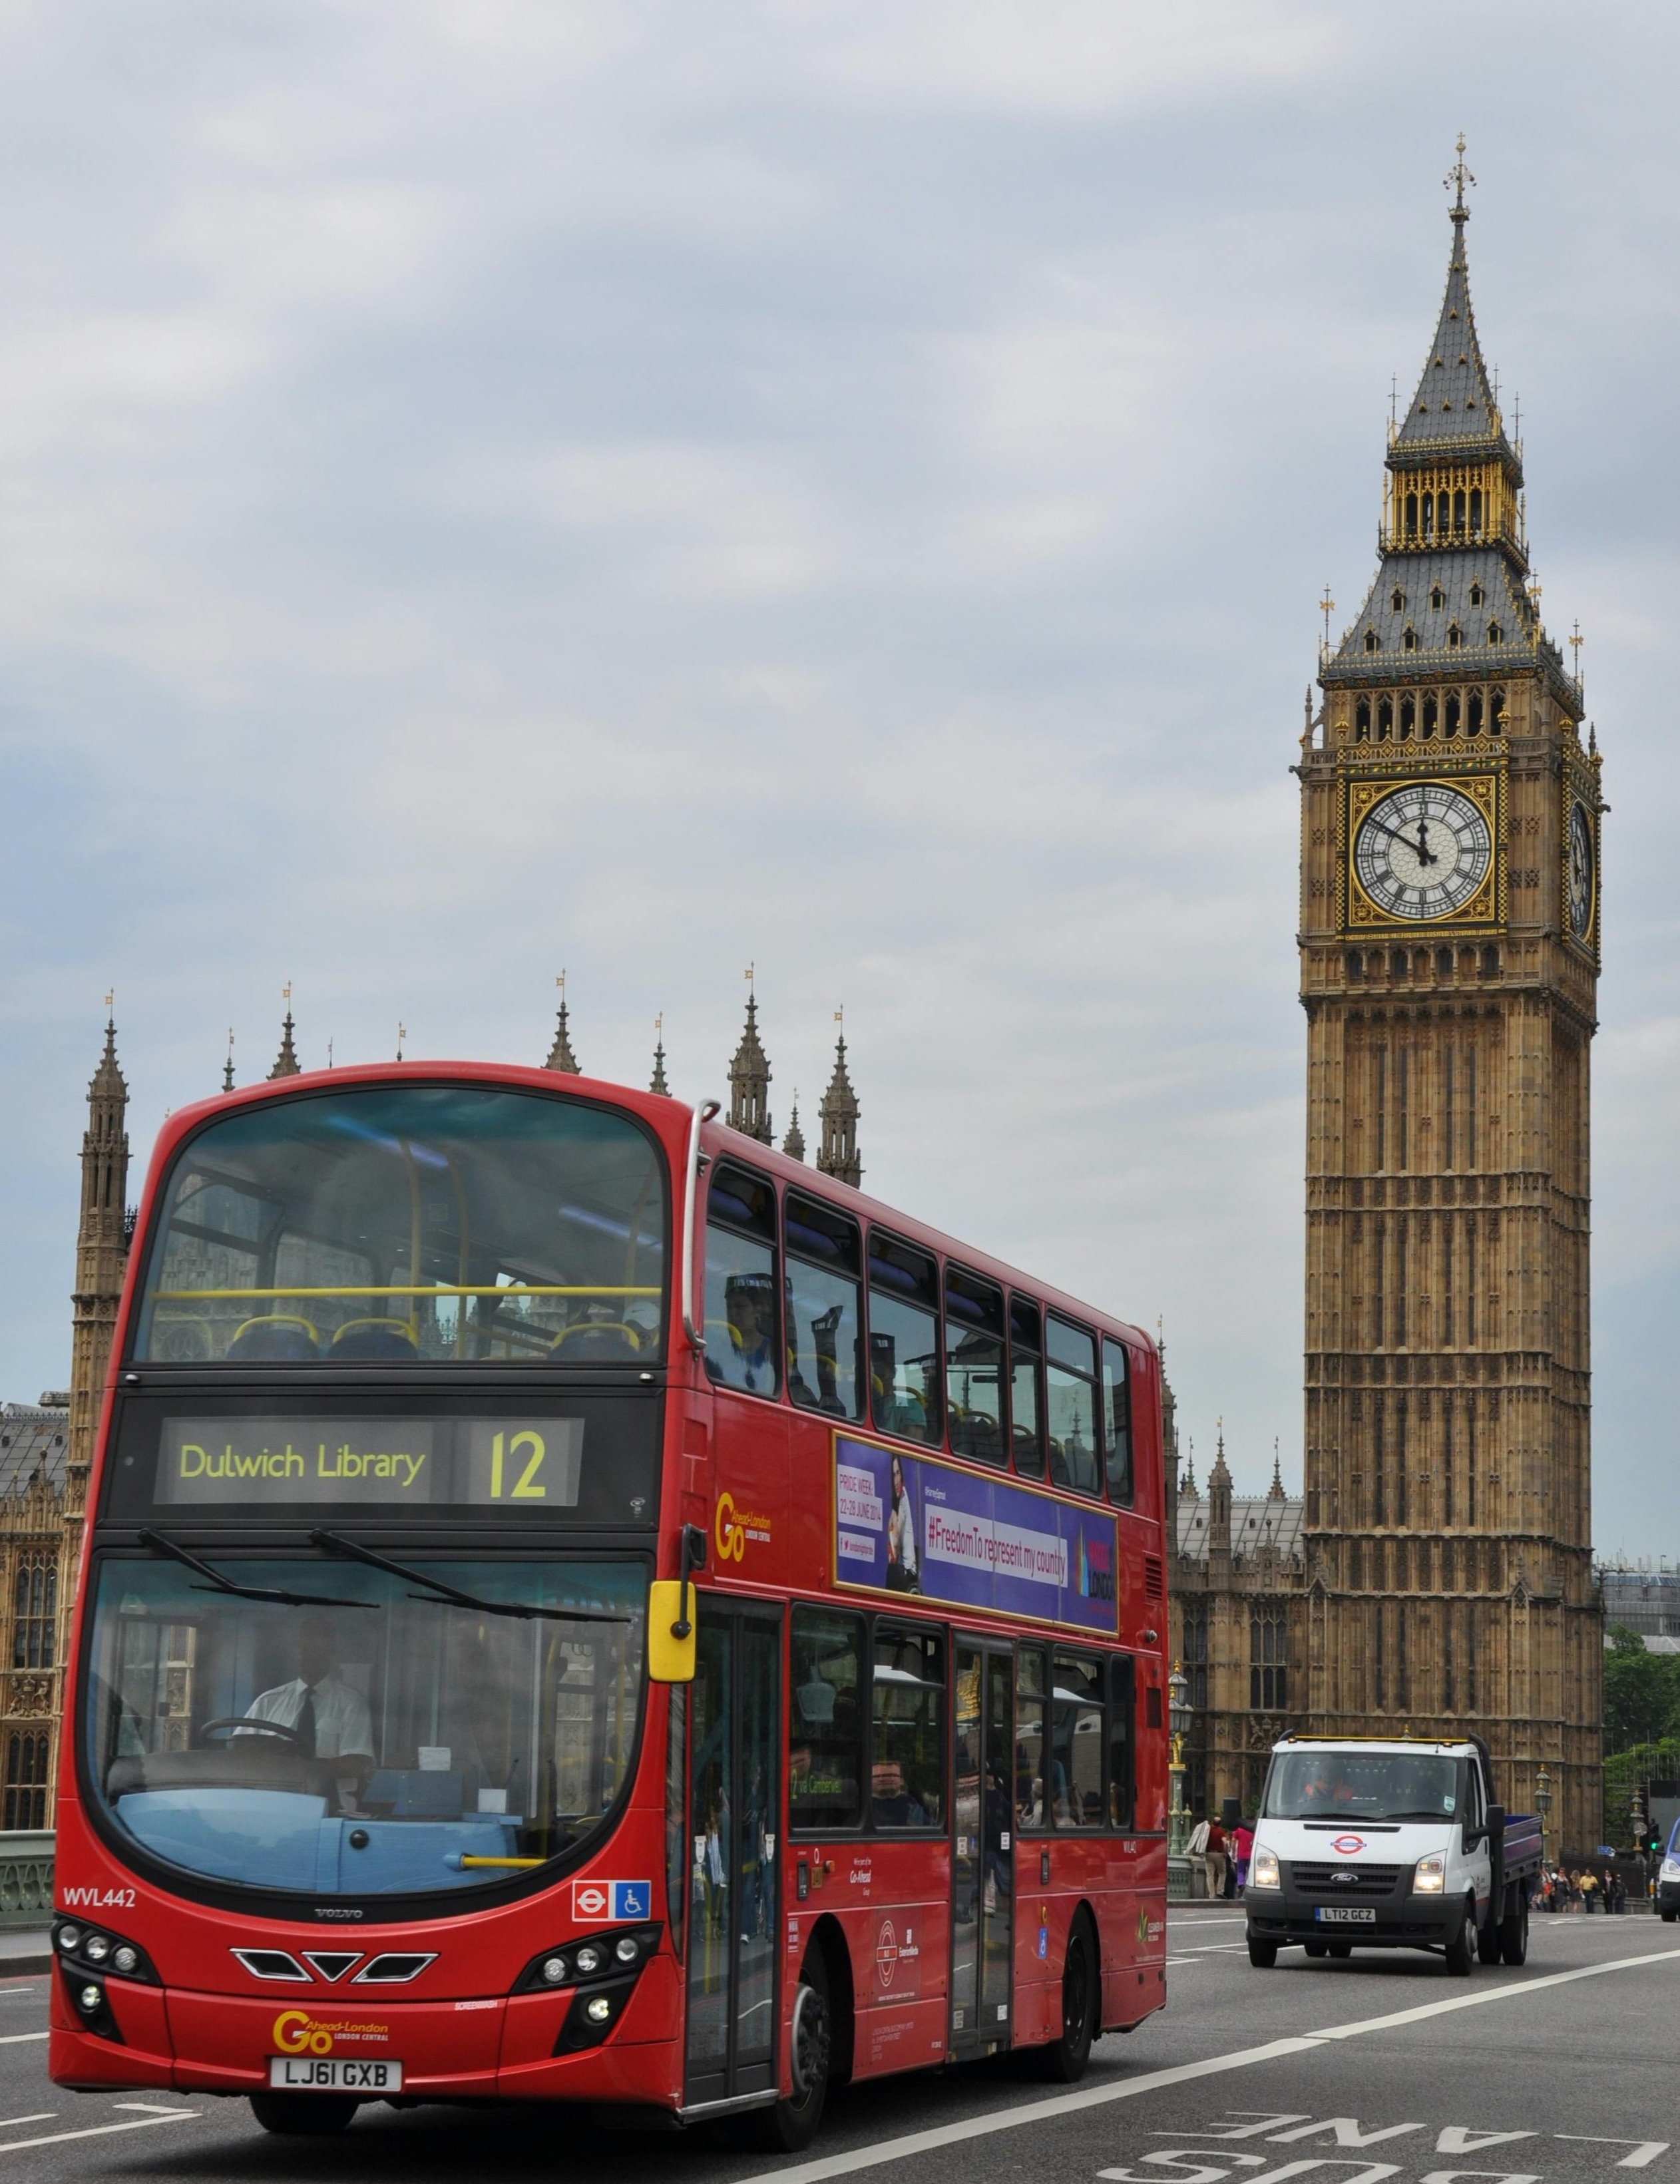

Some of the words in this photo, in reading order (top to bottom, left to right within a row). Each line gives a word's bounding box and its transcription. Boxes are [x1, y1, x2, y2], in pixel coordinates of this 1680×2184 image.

[180, 1444, 304, 1478] Dulwich
[317, 1444, 425, 1486] Library
[490, 1430, 546, 1498] 12
[839, 1474, 857, 1493] PRIDE
[840, 1498, 857, 1516] 22-28
[857, 1502, 870, 1519] JUNE
[870, 1504, 881, 1522] 2014
[716, 1492, 744, 1562] Go
[929, 1516, 982, 1559] #FreedomTo
[984, 1538, 1022, 1567] represent
[1024, 1547, 1036, 1578] my
[1037, 1548, 1065, 1584] country
[64, 1887, 136, 1908] WVL442
[314, 1908, 363, 1919] VOLVO
[1325, 1909, 1349, 1920] LT12
[1351, 1910, 1372, 1920] GCZ
[273, 2010, 332, 2054] Go
[306, 2021, 388, 2032] Ahead-London
[286, 2062, 336, 2085] LJ61
[343, 2064, 387, 2087] GXB
